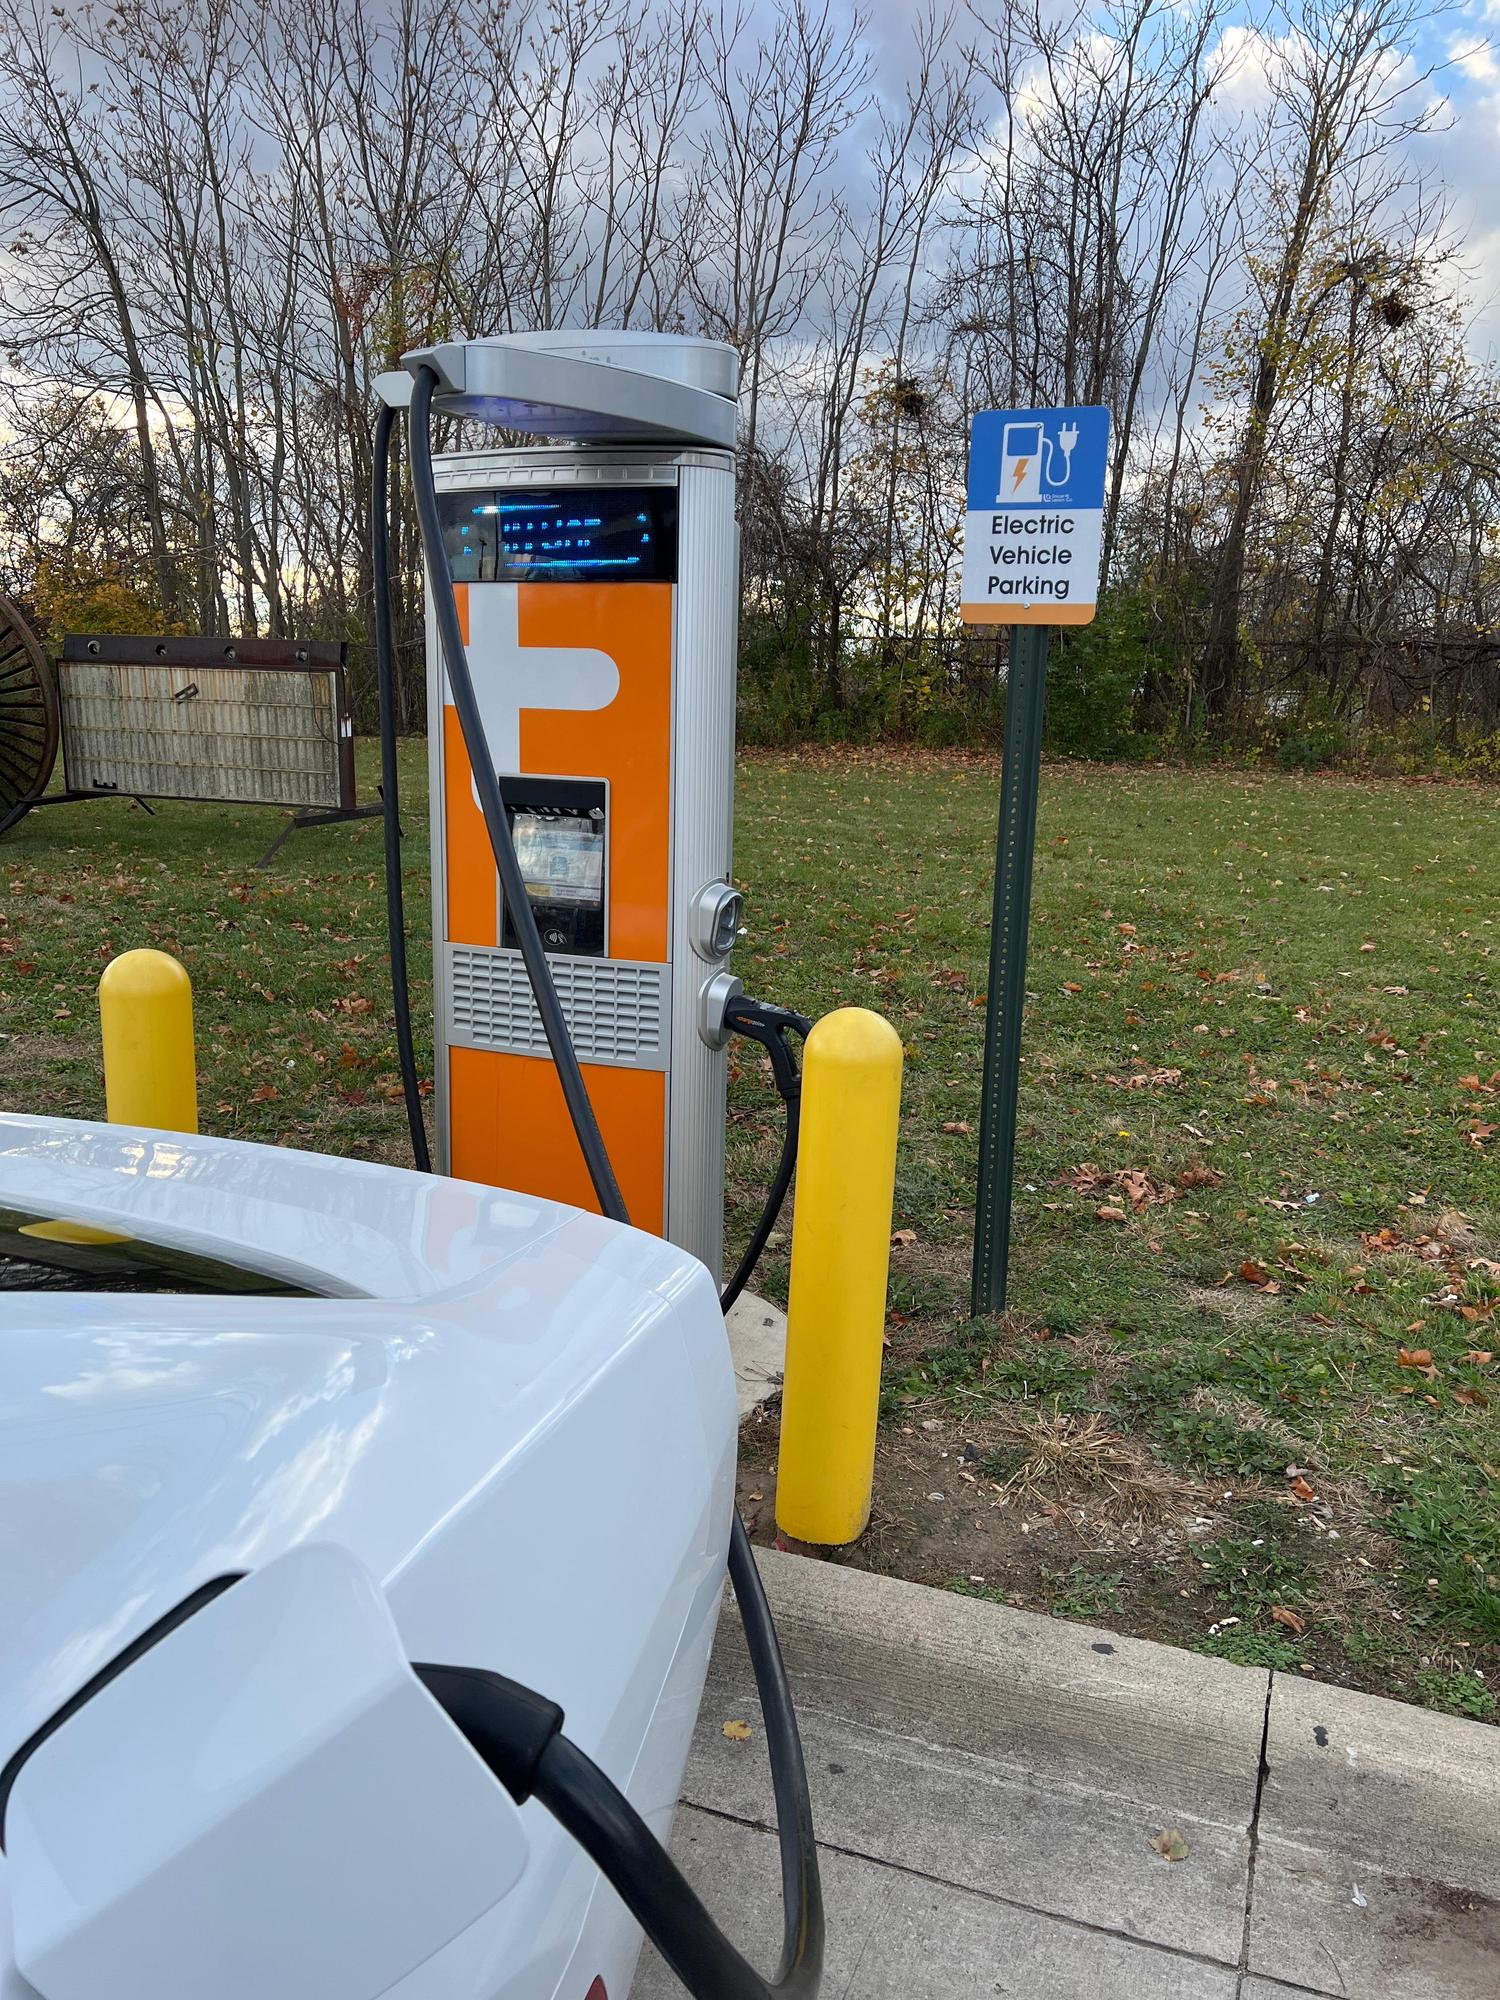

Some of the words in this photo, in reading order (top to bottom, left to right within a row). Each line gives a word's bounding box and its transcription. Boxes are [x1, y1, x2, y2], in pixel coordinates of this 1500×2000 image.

[991, 514, 1075, 535] Electric
[989, 545, 1072, 565] Vehicle
[988, 576, 1070, 599] Parking
